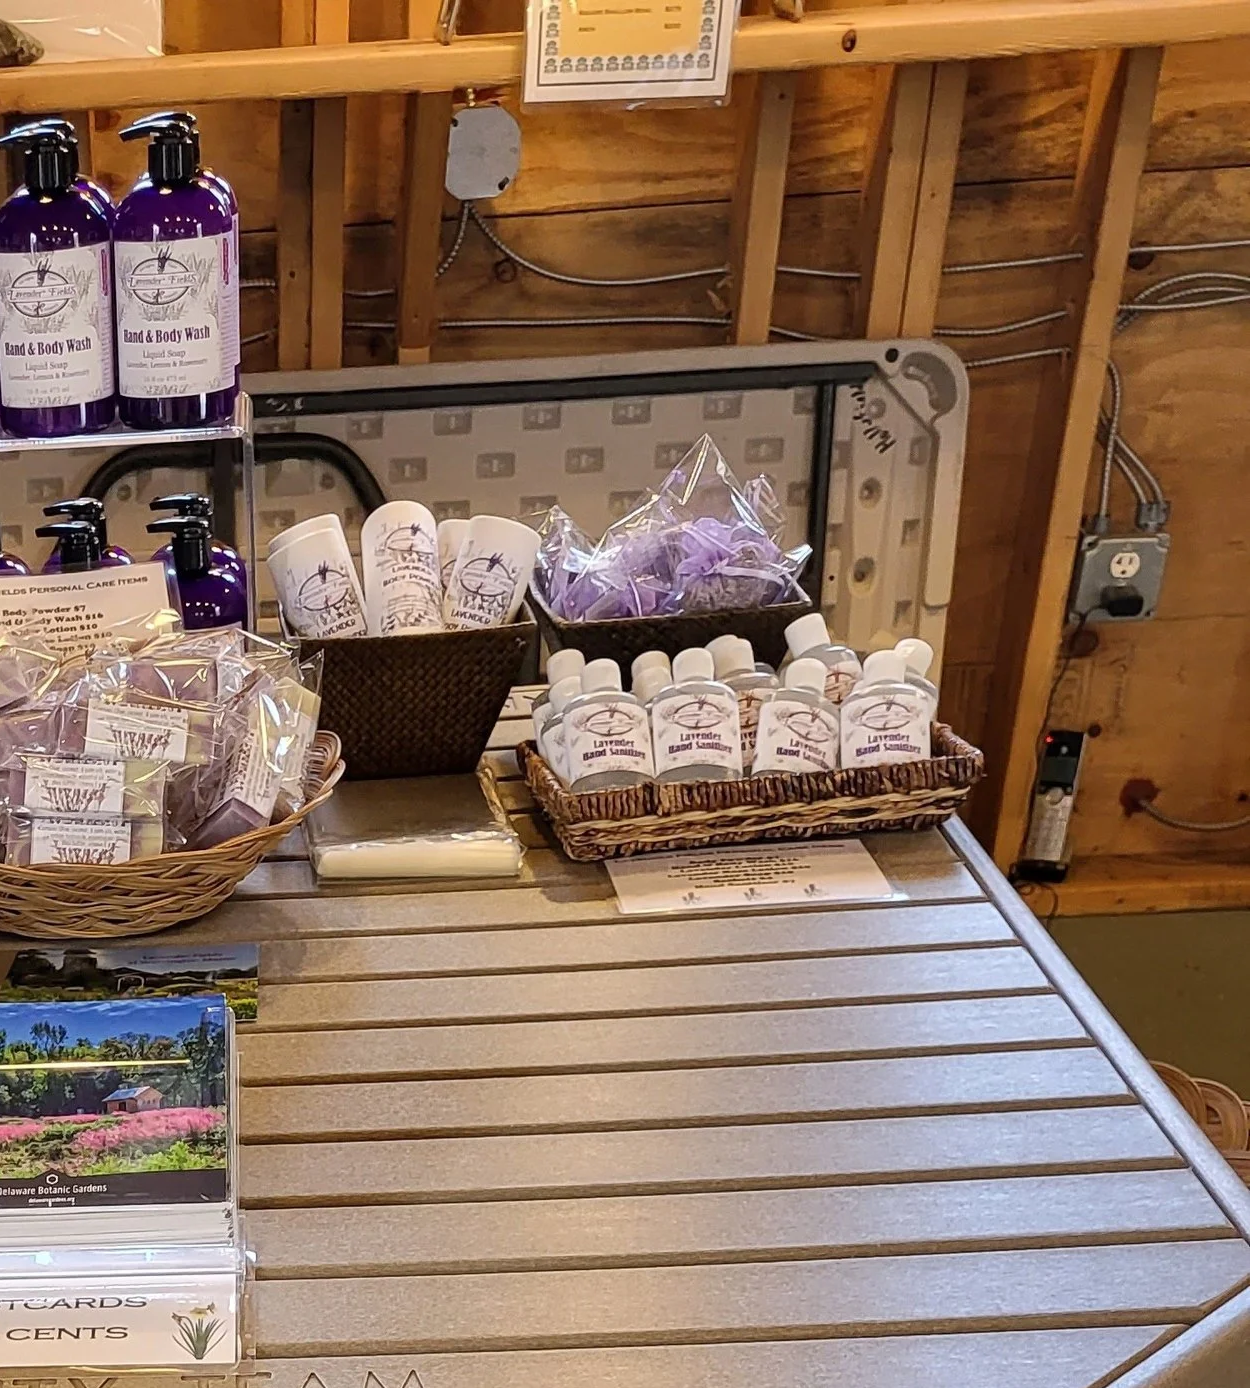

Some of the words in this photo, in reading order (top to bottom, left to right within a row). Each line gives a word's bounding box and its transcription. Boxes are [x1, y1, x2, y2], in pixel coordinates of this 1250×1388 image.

[123, 329, 144, 343] Hand
[145, 329, 154, 343] &
[155, 328, 182, 344] Body
[184, 325, 210, 341] Wash
[28, 342, 35, 355] &
[37, 340, 64, 359] Body
[66, 336, 91, 353] Wash
[29, 584, 84, 595] PERSONAL
[86, 580, 116, 589] CARE
[118, 576, 148, 585] ITEMS
[2, 609, 27, 617] Body
[14, 618, 23, 626] &
[54, 615, 83, 623] Wash
[680, 732, 721, 742] Lavender
[867, 733, 910, 743] Lavender
[593, 739, 635, 748] Lavender
[38, 1185, 70, 1195] Botanic
[73, 1184, 107, 1193] Gardens
[5, 1326, 129, 1341] CENTS
